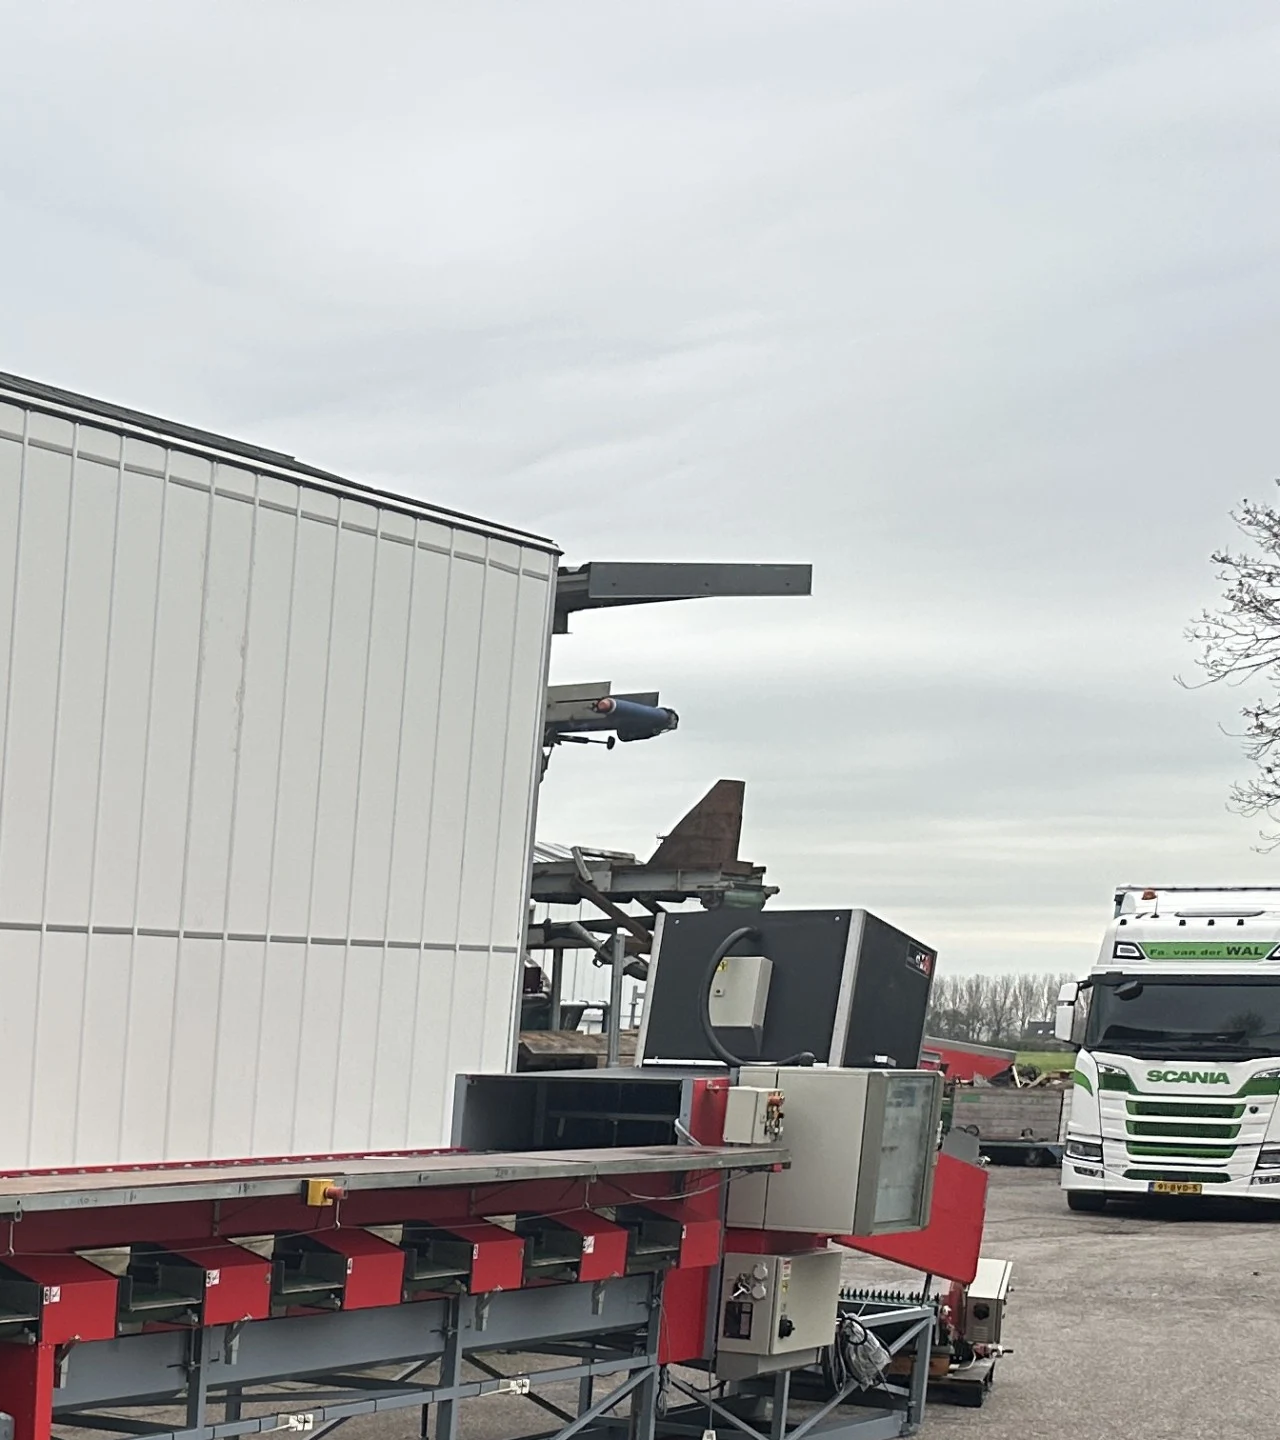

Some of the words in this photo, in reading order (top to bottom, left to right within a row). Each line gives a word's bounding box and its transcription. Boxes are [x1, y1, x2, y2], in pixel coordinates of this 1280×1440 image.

[1200, 948, 1222, 956] der
[1226, 945, 1263, 956] WAL
[1146, 1069, 1231, 1085] SCANIA
